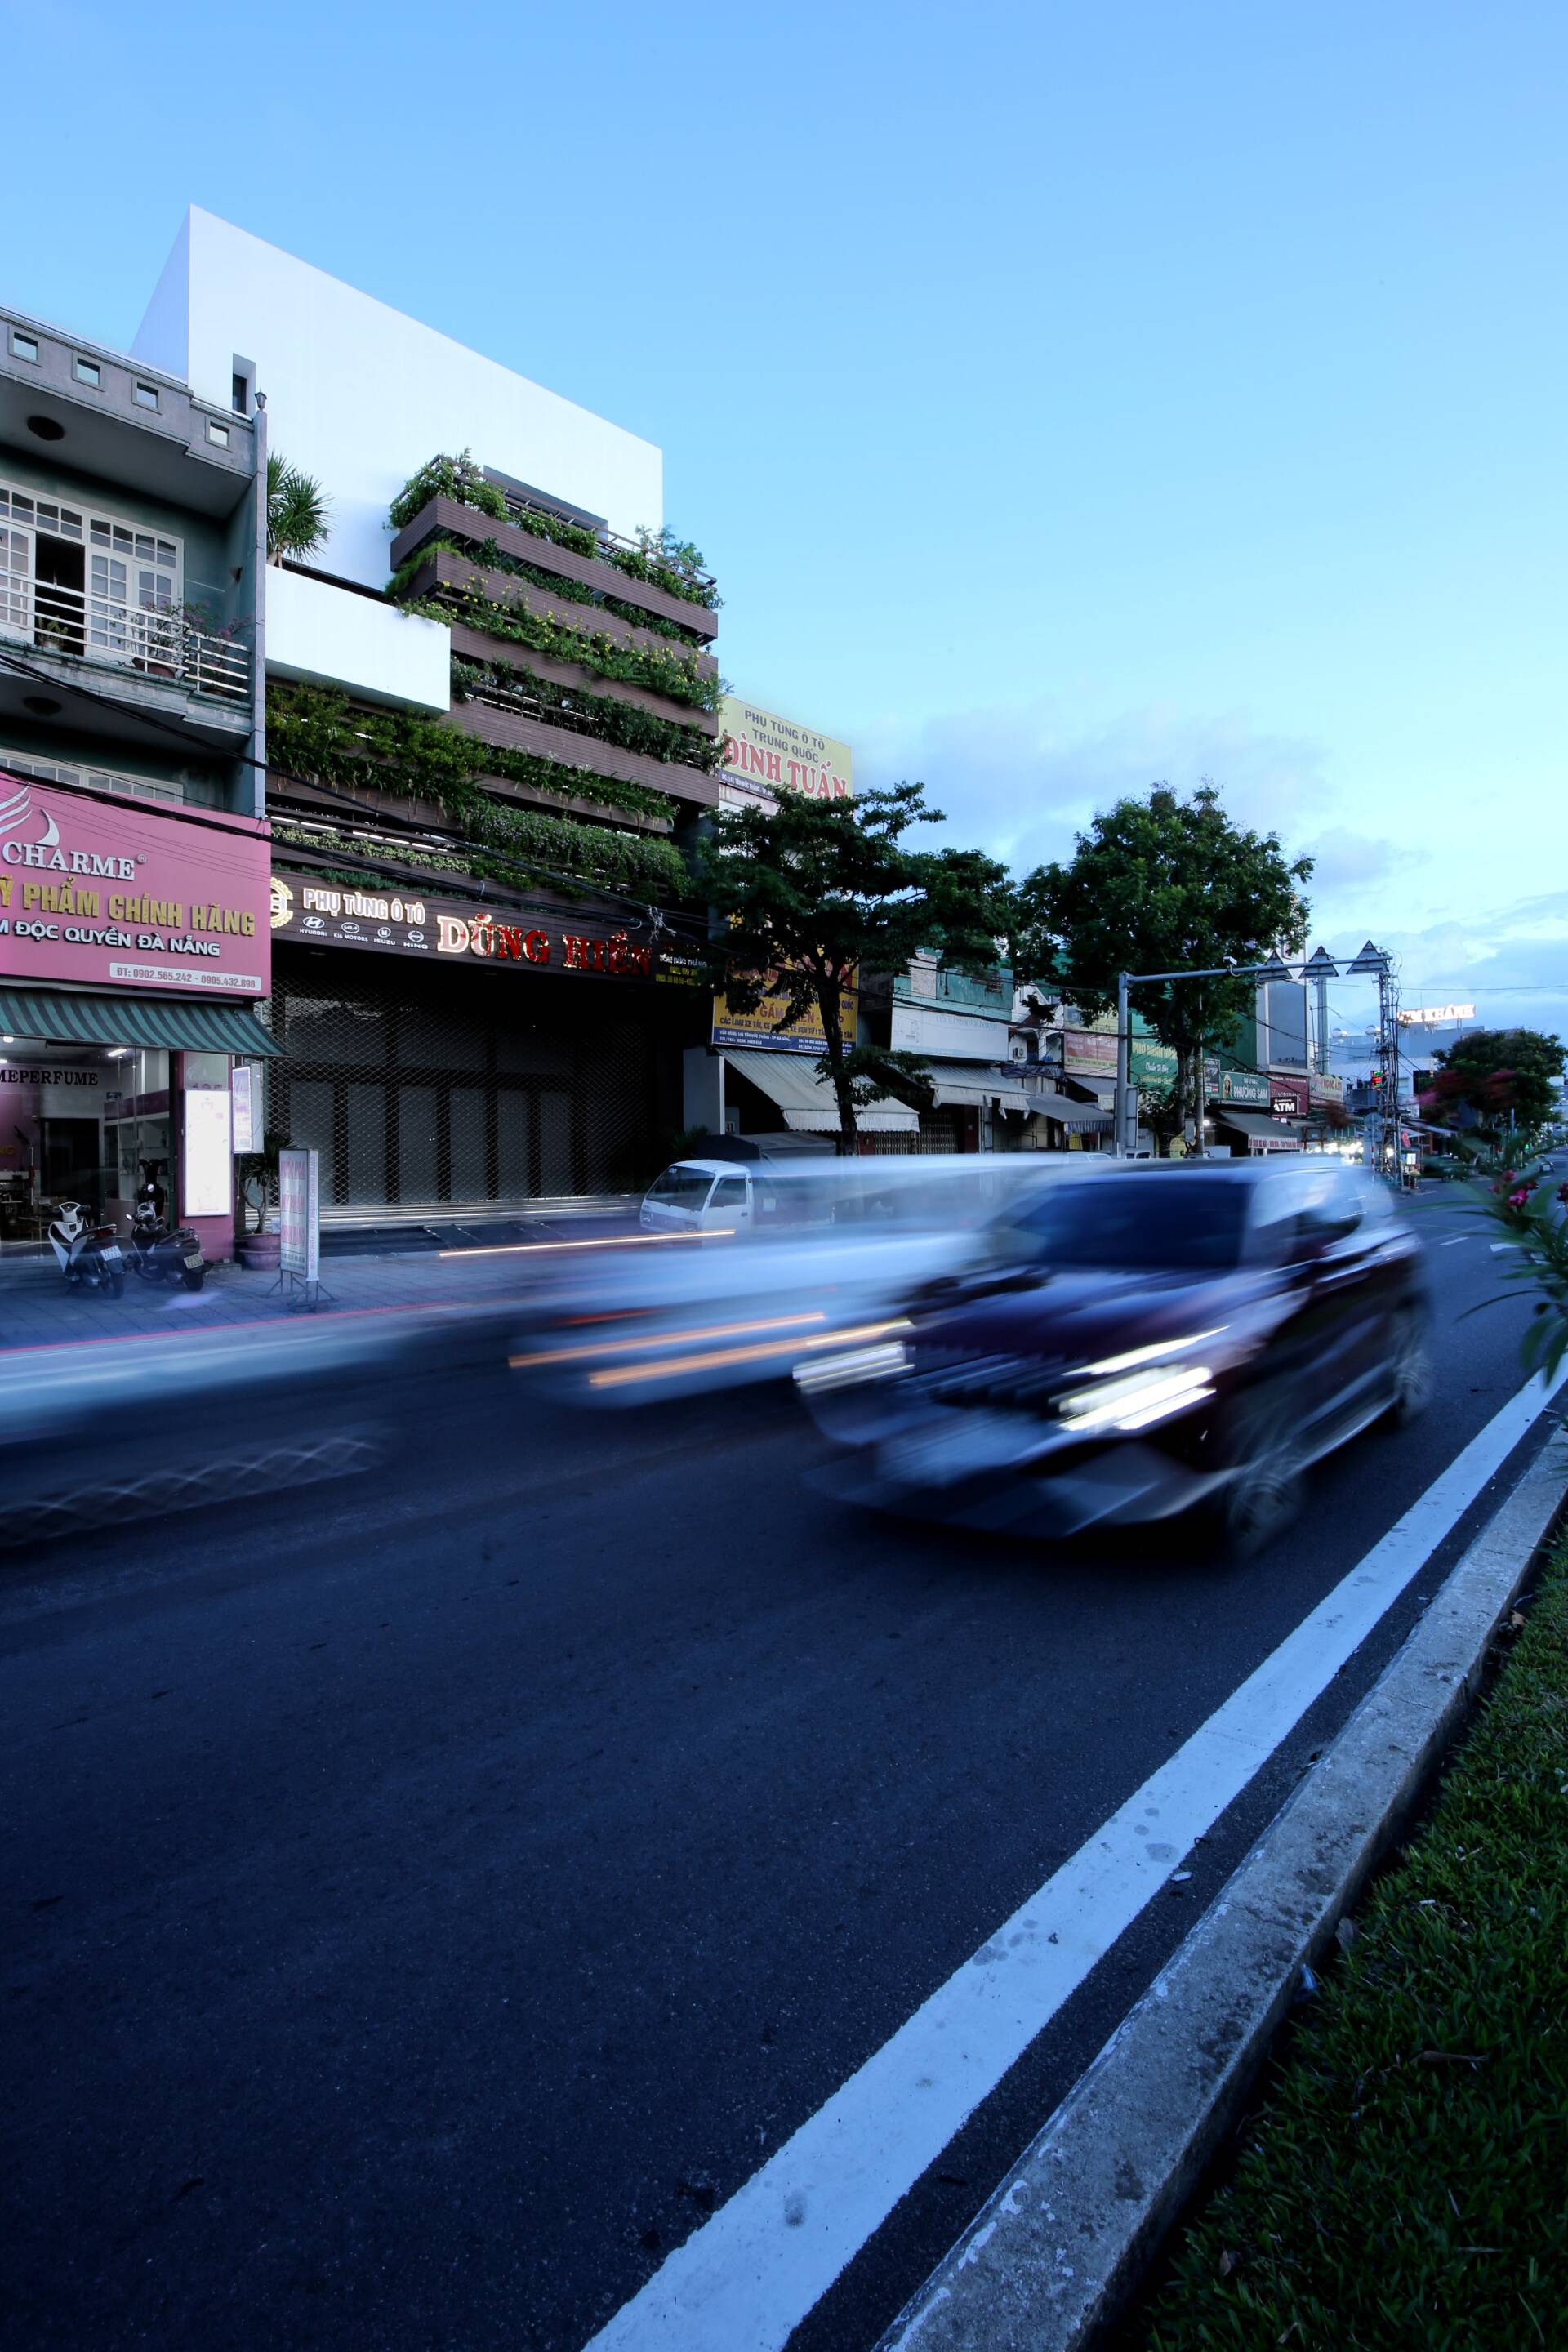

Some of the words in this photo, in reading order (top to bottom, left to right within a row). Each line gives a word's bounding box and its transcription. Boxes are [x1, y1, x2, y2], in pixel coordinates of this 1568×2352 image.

[745, 710, 767, 728] PHỤ
[771, 719, 798, 740] TÙNG
[802, 731, 808, 744] Ô
[812, 737, 825, 751] TÔ
[751, 728, 789, 751] TRUNG
[791, 745, 819, 763] QUỐC
[724, 732, 782, 784] ĐÌNH
[787, 761, 847, 800] TUẤN
[2, 841, 136, 880] CHARME
[24, 876, 99, 918] PHẨM
[109, 893, 183, 929] CHÍNH
[192, 902, 256, 936] HÃNG
[303, 888, 341, 916] PHỤ
[343, 892, 389, 920] TÙNG
[391, 898, 403, 922] Ô
[405, 902, 426, 925] TÔ
[15, 920, 59, 939] ĐỘC
[65, 926, 131, 947] QUYỀN
[138, 935, 166, 951] ĐÀ
[171, 934, 220, 956] NẴNG
[300, 928, 327, 937] HYUNDAI
[437, 913, 550, 964] DŨNG
[117, 967, 131, 978] ĐT:
[133, 969, 192, 982] 0902.565.242
[0, 1070, 98, 1086] MEPERFUME
[1257, 1087, 1268, 1100] SAM
[1273, 1102, 1295, 1112] ATM
